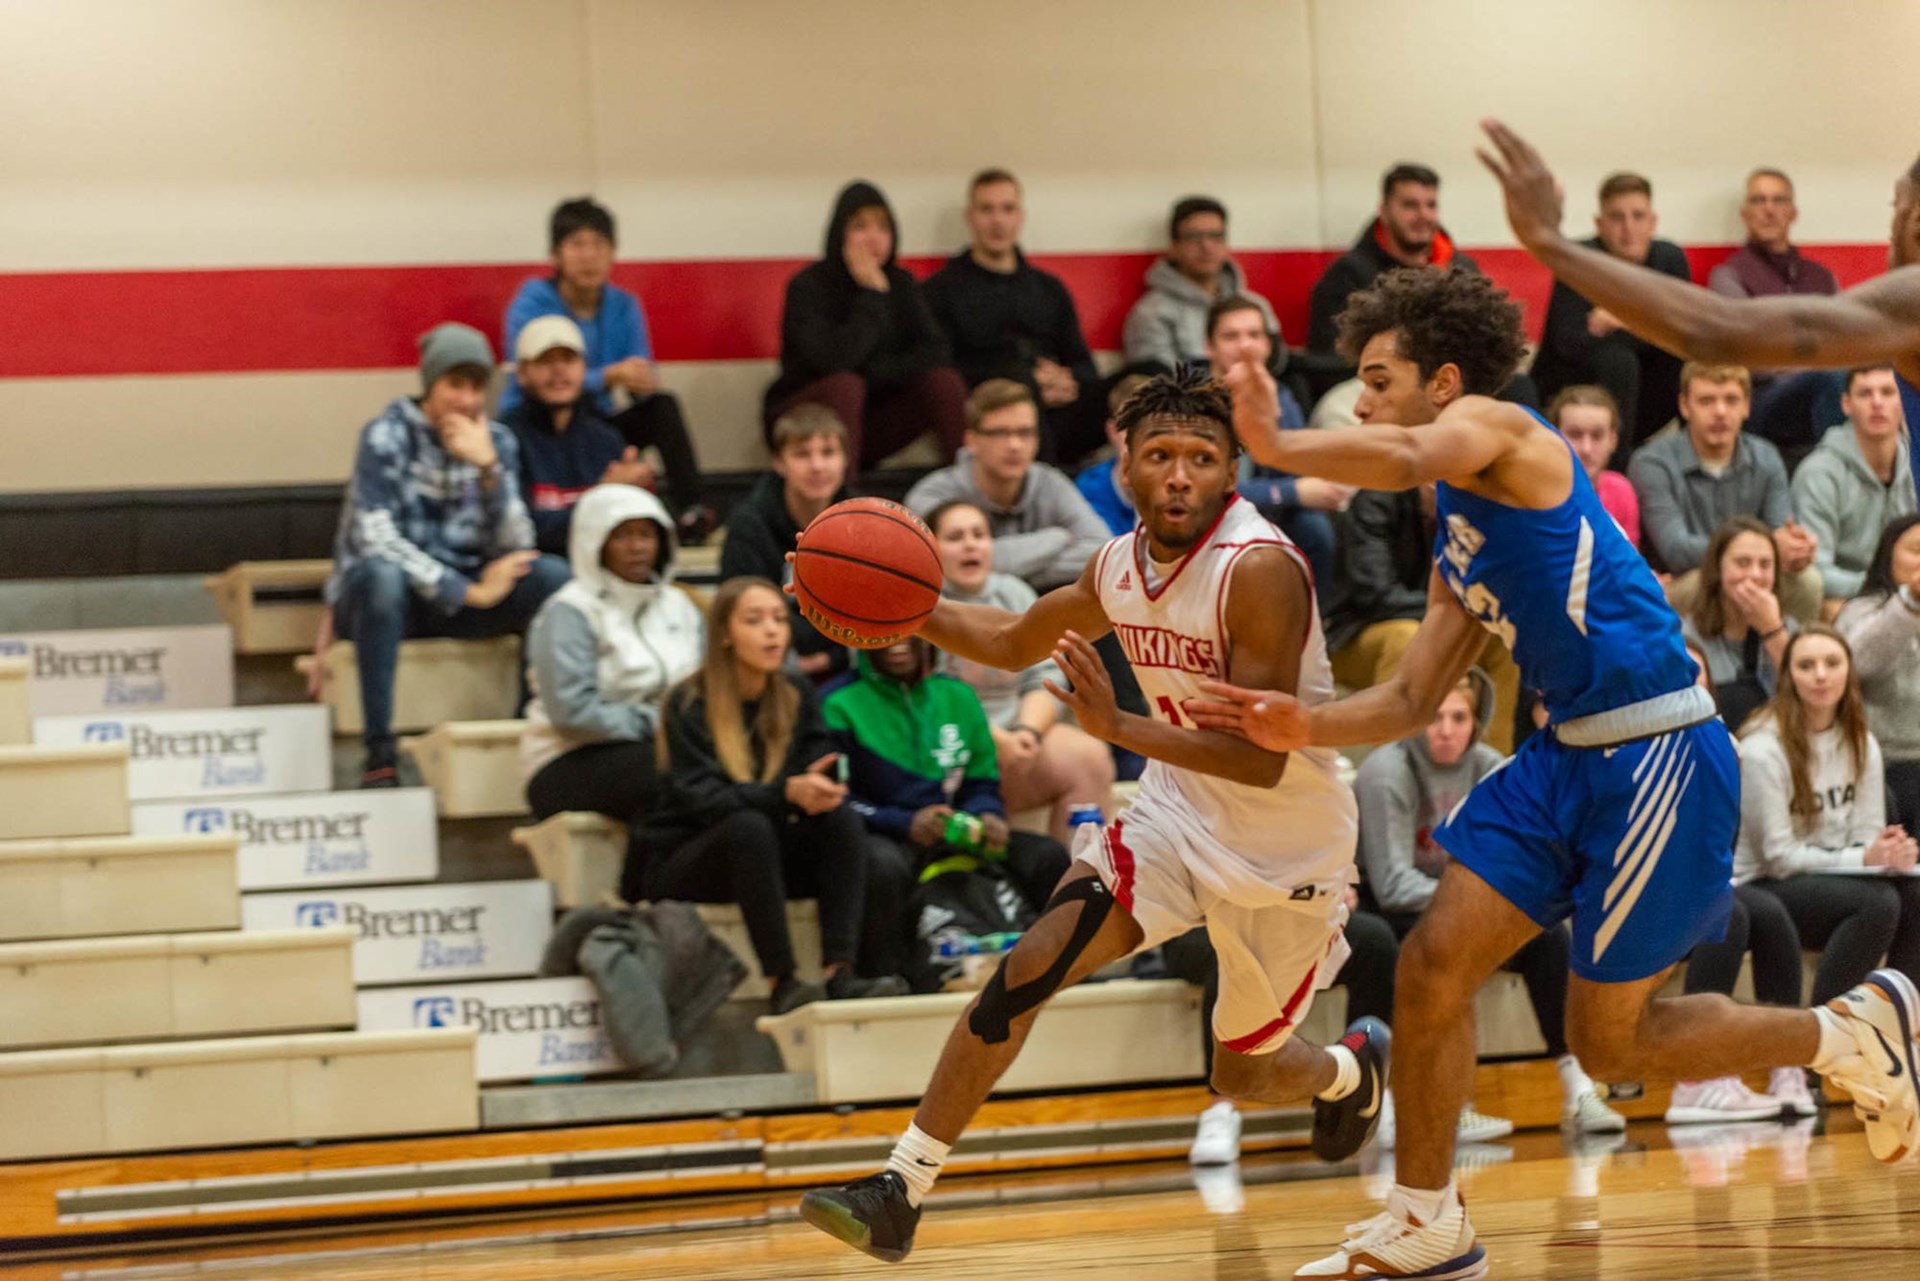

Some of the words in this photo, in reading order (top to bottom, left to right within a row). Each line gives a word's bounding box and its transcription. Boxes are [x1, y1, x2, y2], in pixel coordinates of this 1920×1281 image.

[33, 643, 166, 678] Bremer
[130, 724, 265, 758] Bremer
[230, 808, 370, 845] Bremer
[344, 902, 486, 940] Bremer
[462, 996, 601, 1035] Bremer
